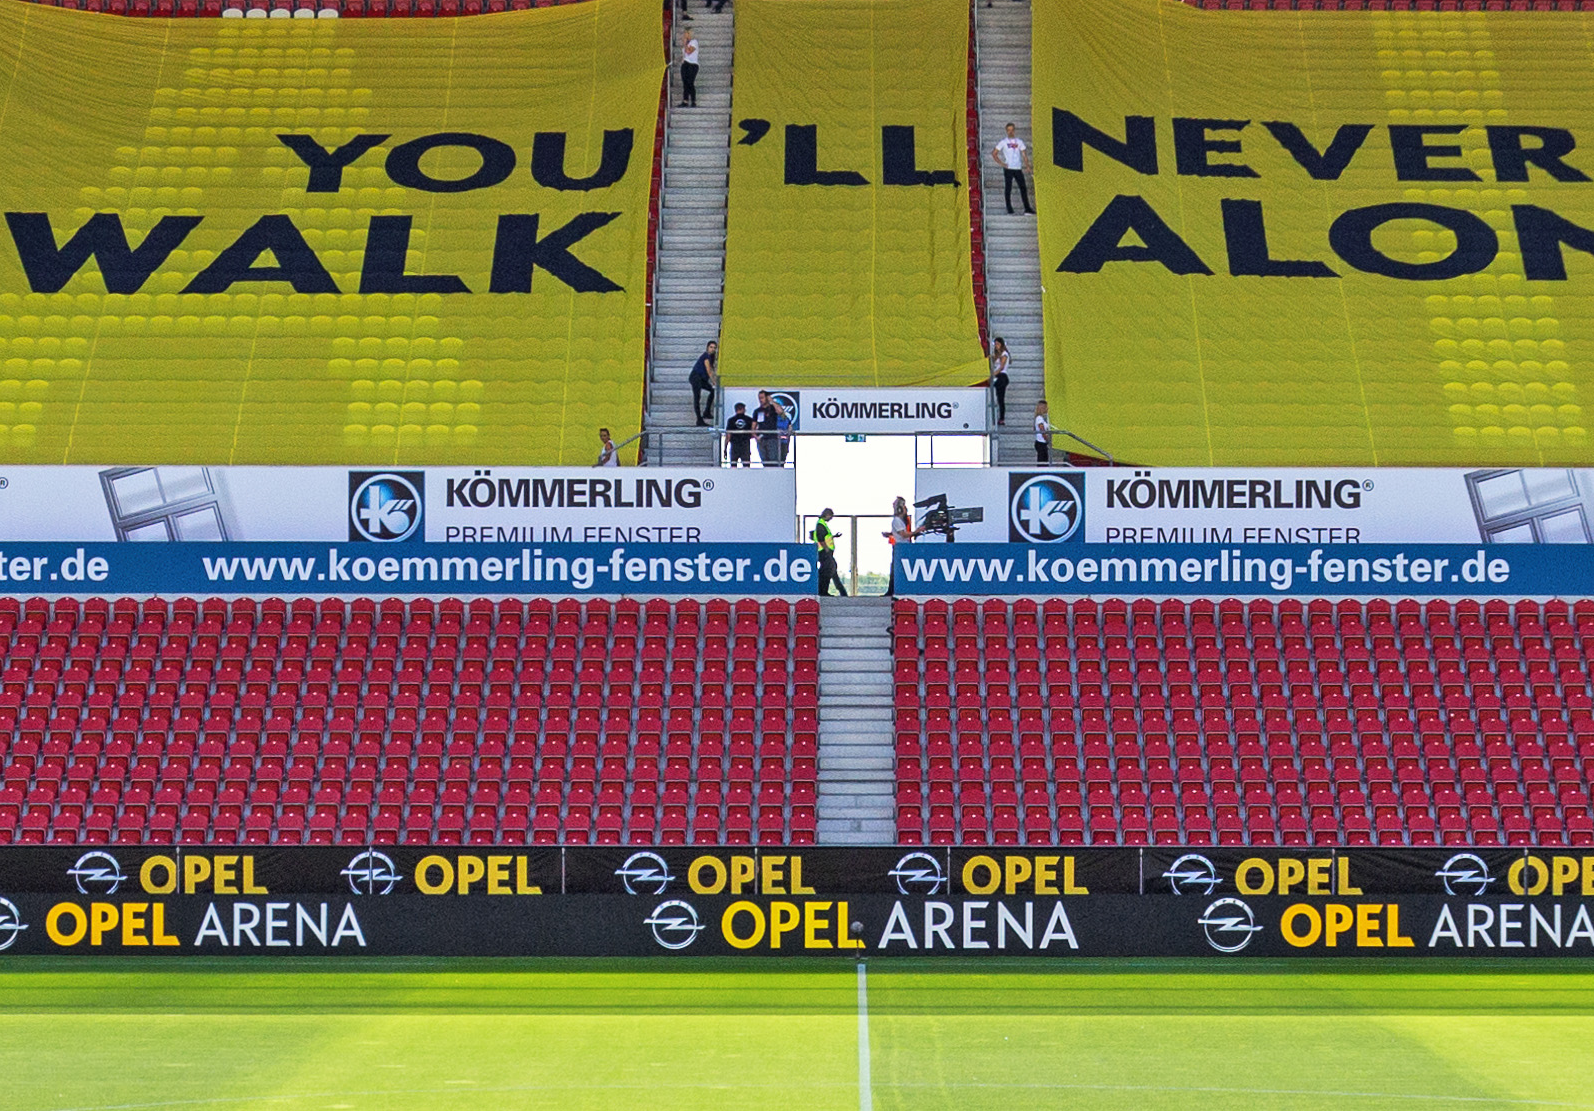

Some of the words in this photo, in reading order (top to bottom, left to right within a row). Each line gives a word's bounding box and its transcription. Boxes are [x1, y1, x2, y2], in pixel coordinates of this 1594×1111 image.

[277, 128, 633, 193] YOU
[1052, 107, 1593, 182] NEVER
[5, 212, 626, 294] WALK
[203, 549, 811, 589] www.koemmerling-fenster.de
[901, 550, 1509, 590] www.koemmerling-fenster.de
[139, 854, 269, 895] OPEL
[414, 854, 542, 895] OPEL
[687, 855, 816, 895] OPEL
[961, 854, 1089, 895] OPEL
[1234, 856, 1363, 896] OPEL
[46, 902, 180, 946] OPEL
[194, 902, 366, 946] ARENA
[722, 901, 865, 949] OPEL
[878, 901, 1078, 949] ARENA
[1281, 904, 1415, 947] OPEL
